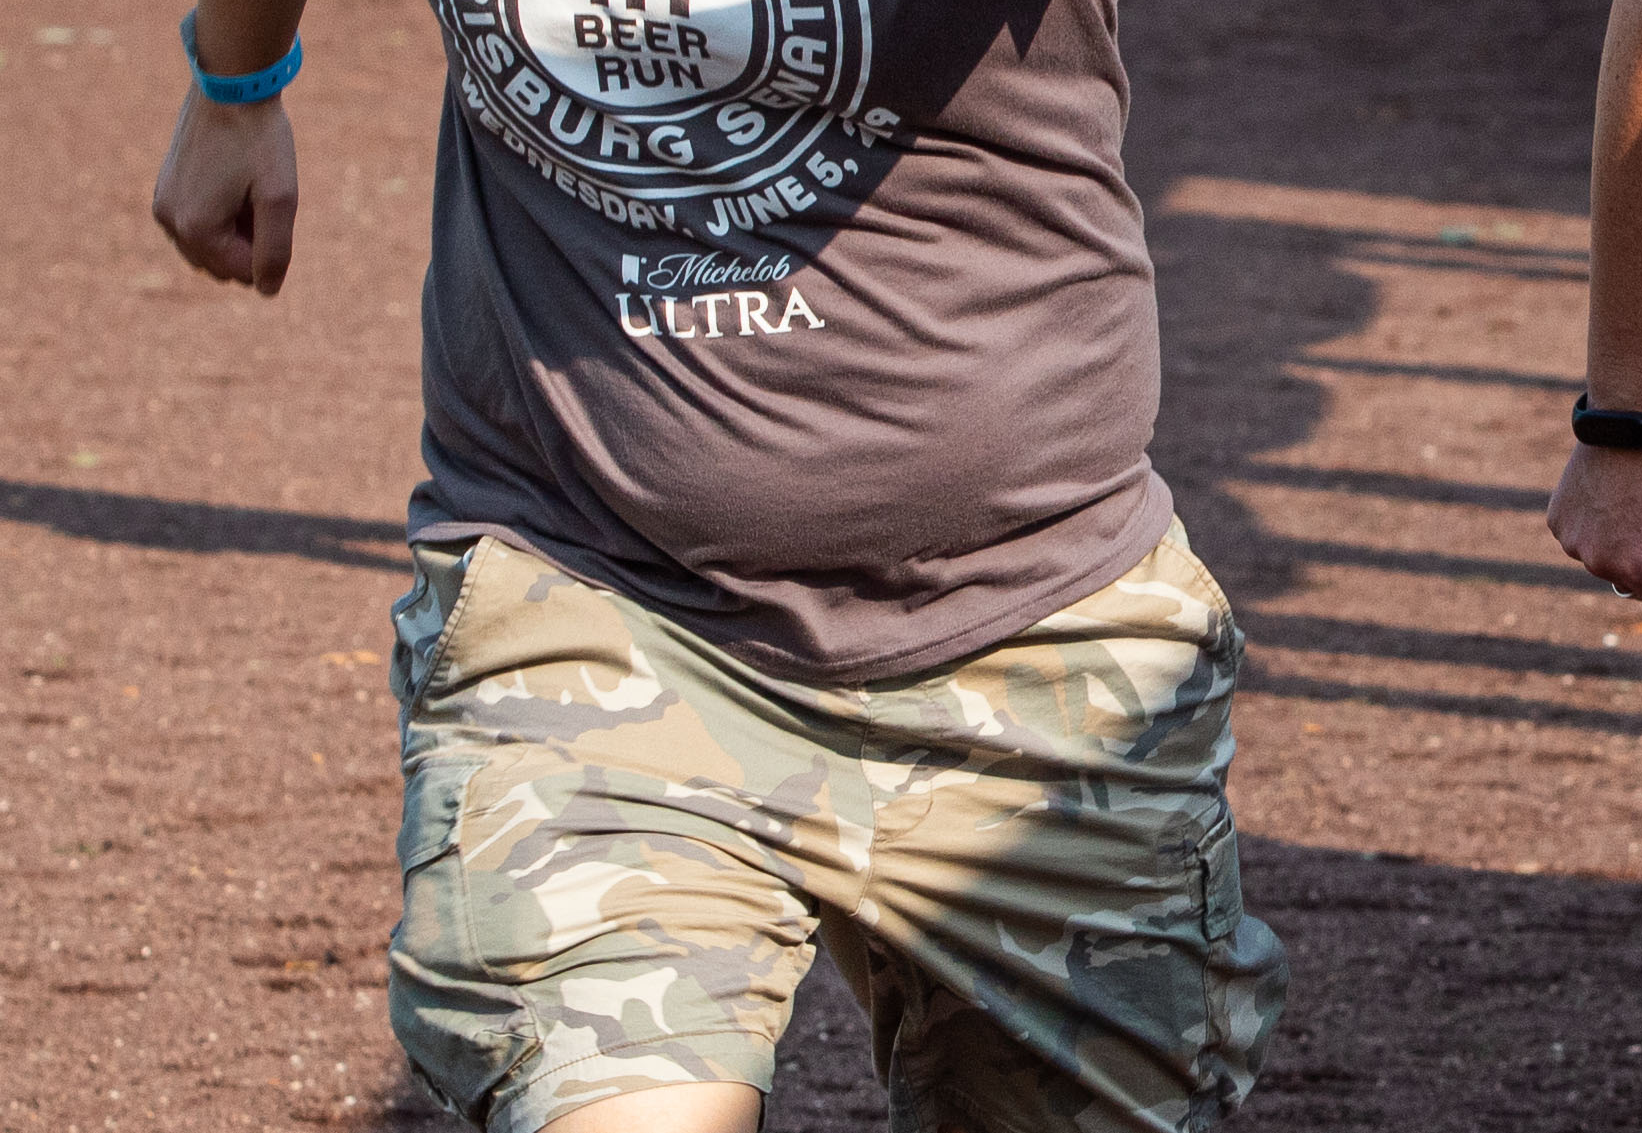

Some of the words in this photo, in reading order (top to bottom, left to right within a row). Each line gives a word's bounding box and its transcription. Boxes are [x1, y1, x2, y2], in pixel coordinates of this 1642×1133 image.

[574, 14, 711, 59] BEER
[595, 54, 705, 92] RUN
[706, 176, 817, 237] JUNE
[805, 151, 859, 188] 5,
[646, 250, 791, 289] Michelob
[615, 286, 826, 339] ULTRA
